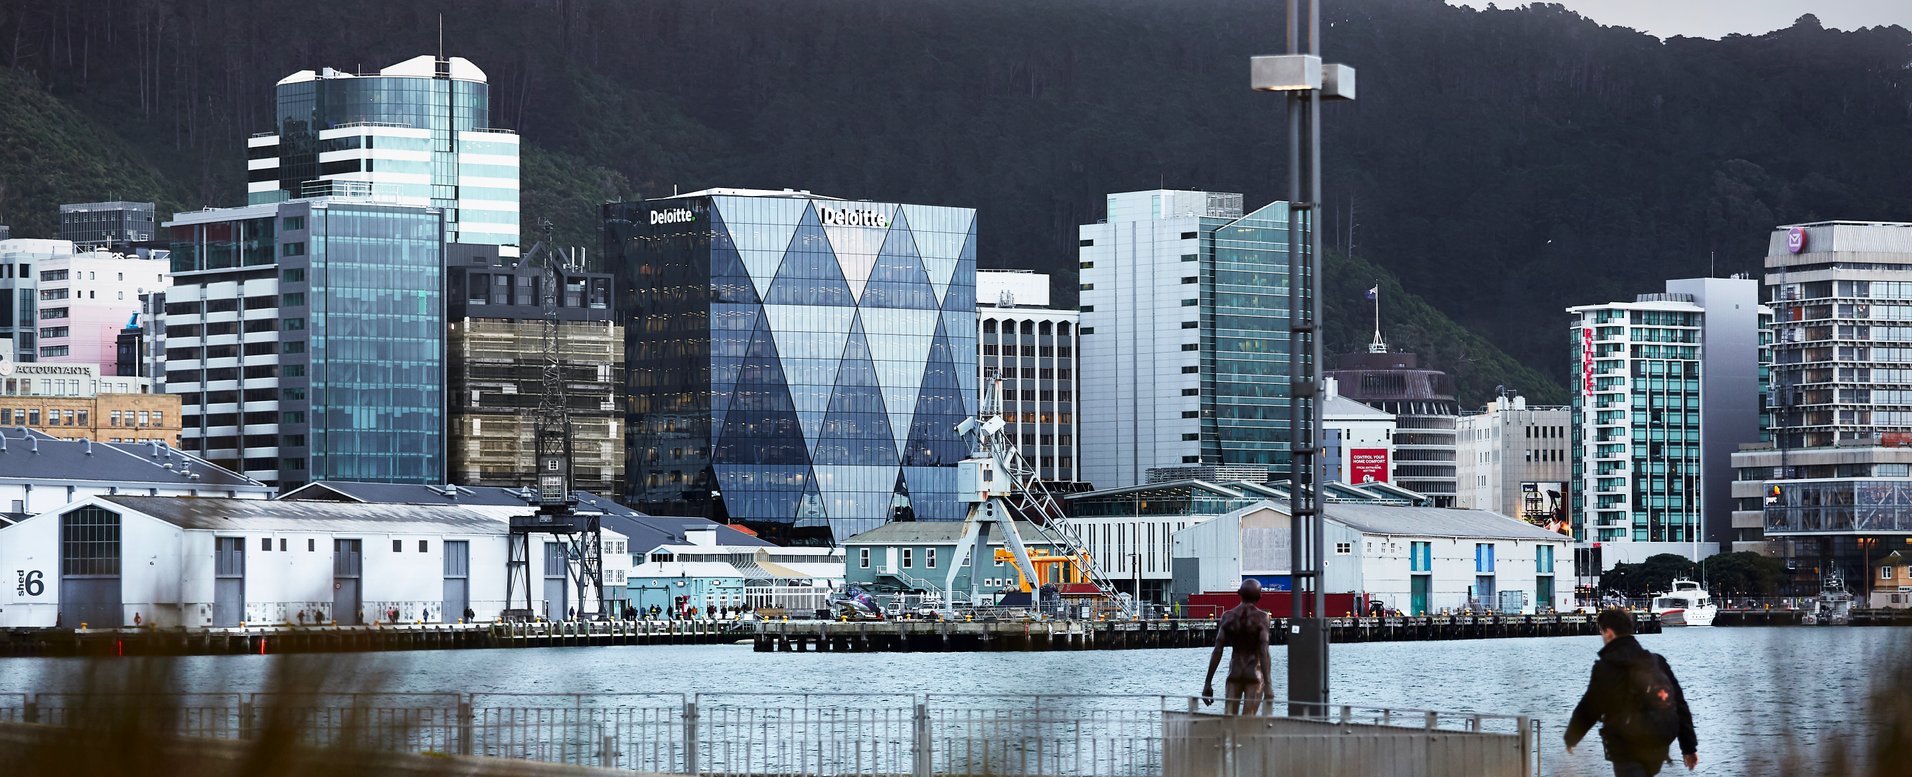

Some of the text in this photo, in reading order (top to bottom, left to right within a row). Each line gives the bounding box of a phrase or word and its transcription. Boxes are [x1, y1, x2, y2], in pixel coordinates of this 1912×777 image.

[16, 365, 90, 376] ACCOUNTANTS
[1585, 328, 1593, 396] RYDGES
[16, 570, 44, 596] shed 6
